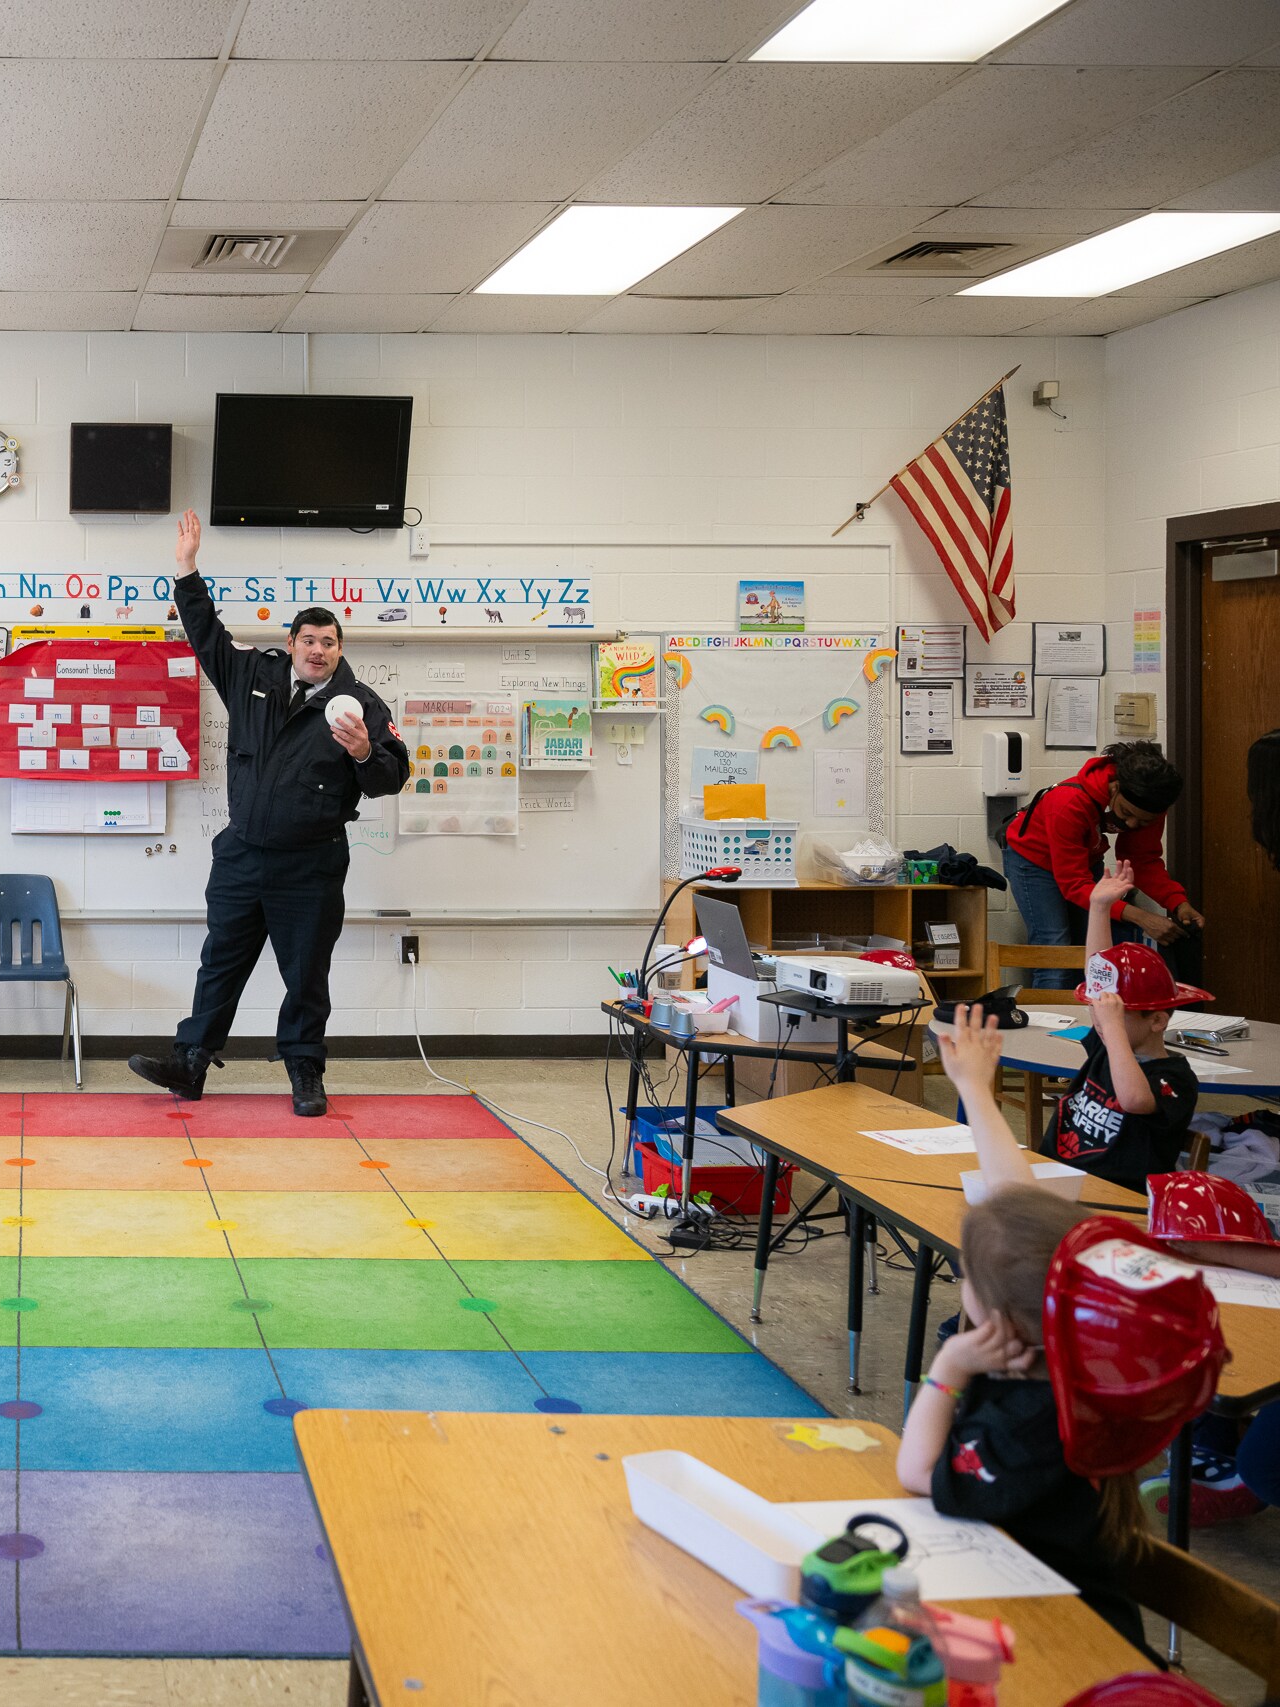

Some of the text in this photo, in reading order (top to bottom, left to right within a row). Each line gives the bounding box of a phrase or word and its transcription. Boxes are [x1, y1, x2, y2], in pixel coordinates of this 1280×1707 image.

[20, 574, 51, 599] Nn
[66, 575, 100, 599] Oo
[108, 577, 139, 607] Pp
[153, 577, 170, 603] Q
[245, 578, 275, 603] Ss
[286, 578, 318, 603] Tt
[331, 578, 362, 603] Uu
[378, 579, 408, 604] Vv
[417, 580, 465, 604] Ww
[477, 579, 505, 604] Xx
[520, 580, 551, 610] Yy
[558, 580, 588, 604] Zz
[503, 649, 531, 661] Unit 5
[616, 652, 640, 661] WILD
[57, 663, 115, 675] Consonant blends
[427, 668, 465, 680] Calendar
[501, 675, 587, 691] Exploring New Things
[423, 701, 454, 713] MARCH
[143, 712, 153, 721] sh
[544, 737, 583, 749] JABARI
[487, 750, 492, 758] 8
[506, 750, 511, 758] 9
[714, 750, 738, 758] ROOM
[166, 758, 175, 767] ch
[719, 758, 732, 766] 130
[504, 767, 512, 775] 16
[704, 764, 748, 775] MAILBOXES
[518, 797, 571, 808] Trick Words
